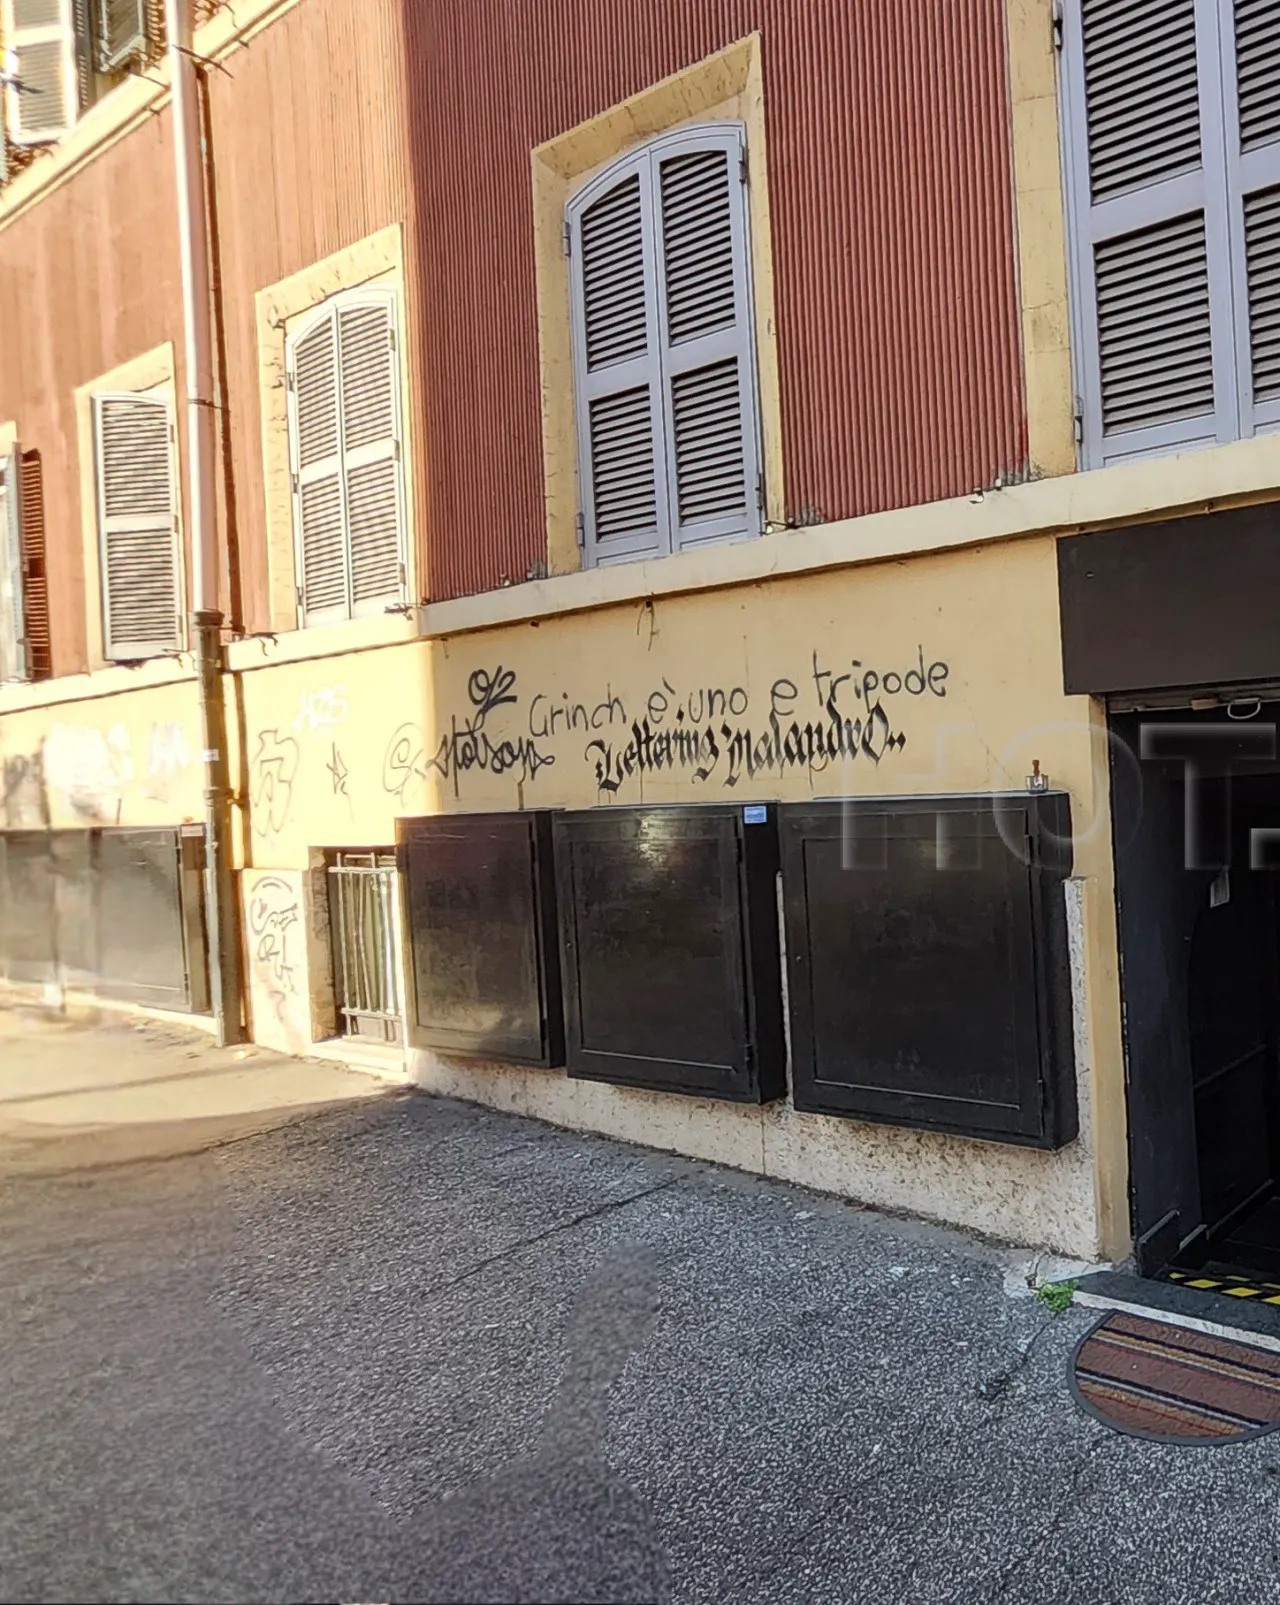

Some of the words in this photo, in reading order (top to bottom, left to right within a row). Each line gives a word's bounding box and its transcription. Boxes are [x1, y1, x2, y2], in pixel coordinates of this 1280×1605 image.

[529, 683, 627, 737] Grinch
[688, 687, 748, 724] uno
[770, 679, 798, 716] e
[812, 644, 949, 714] tripode
